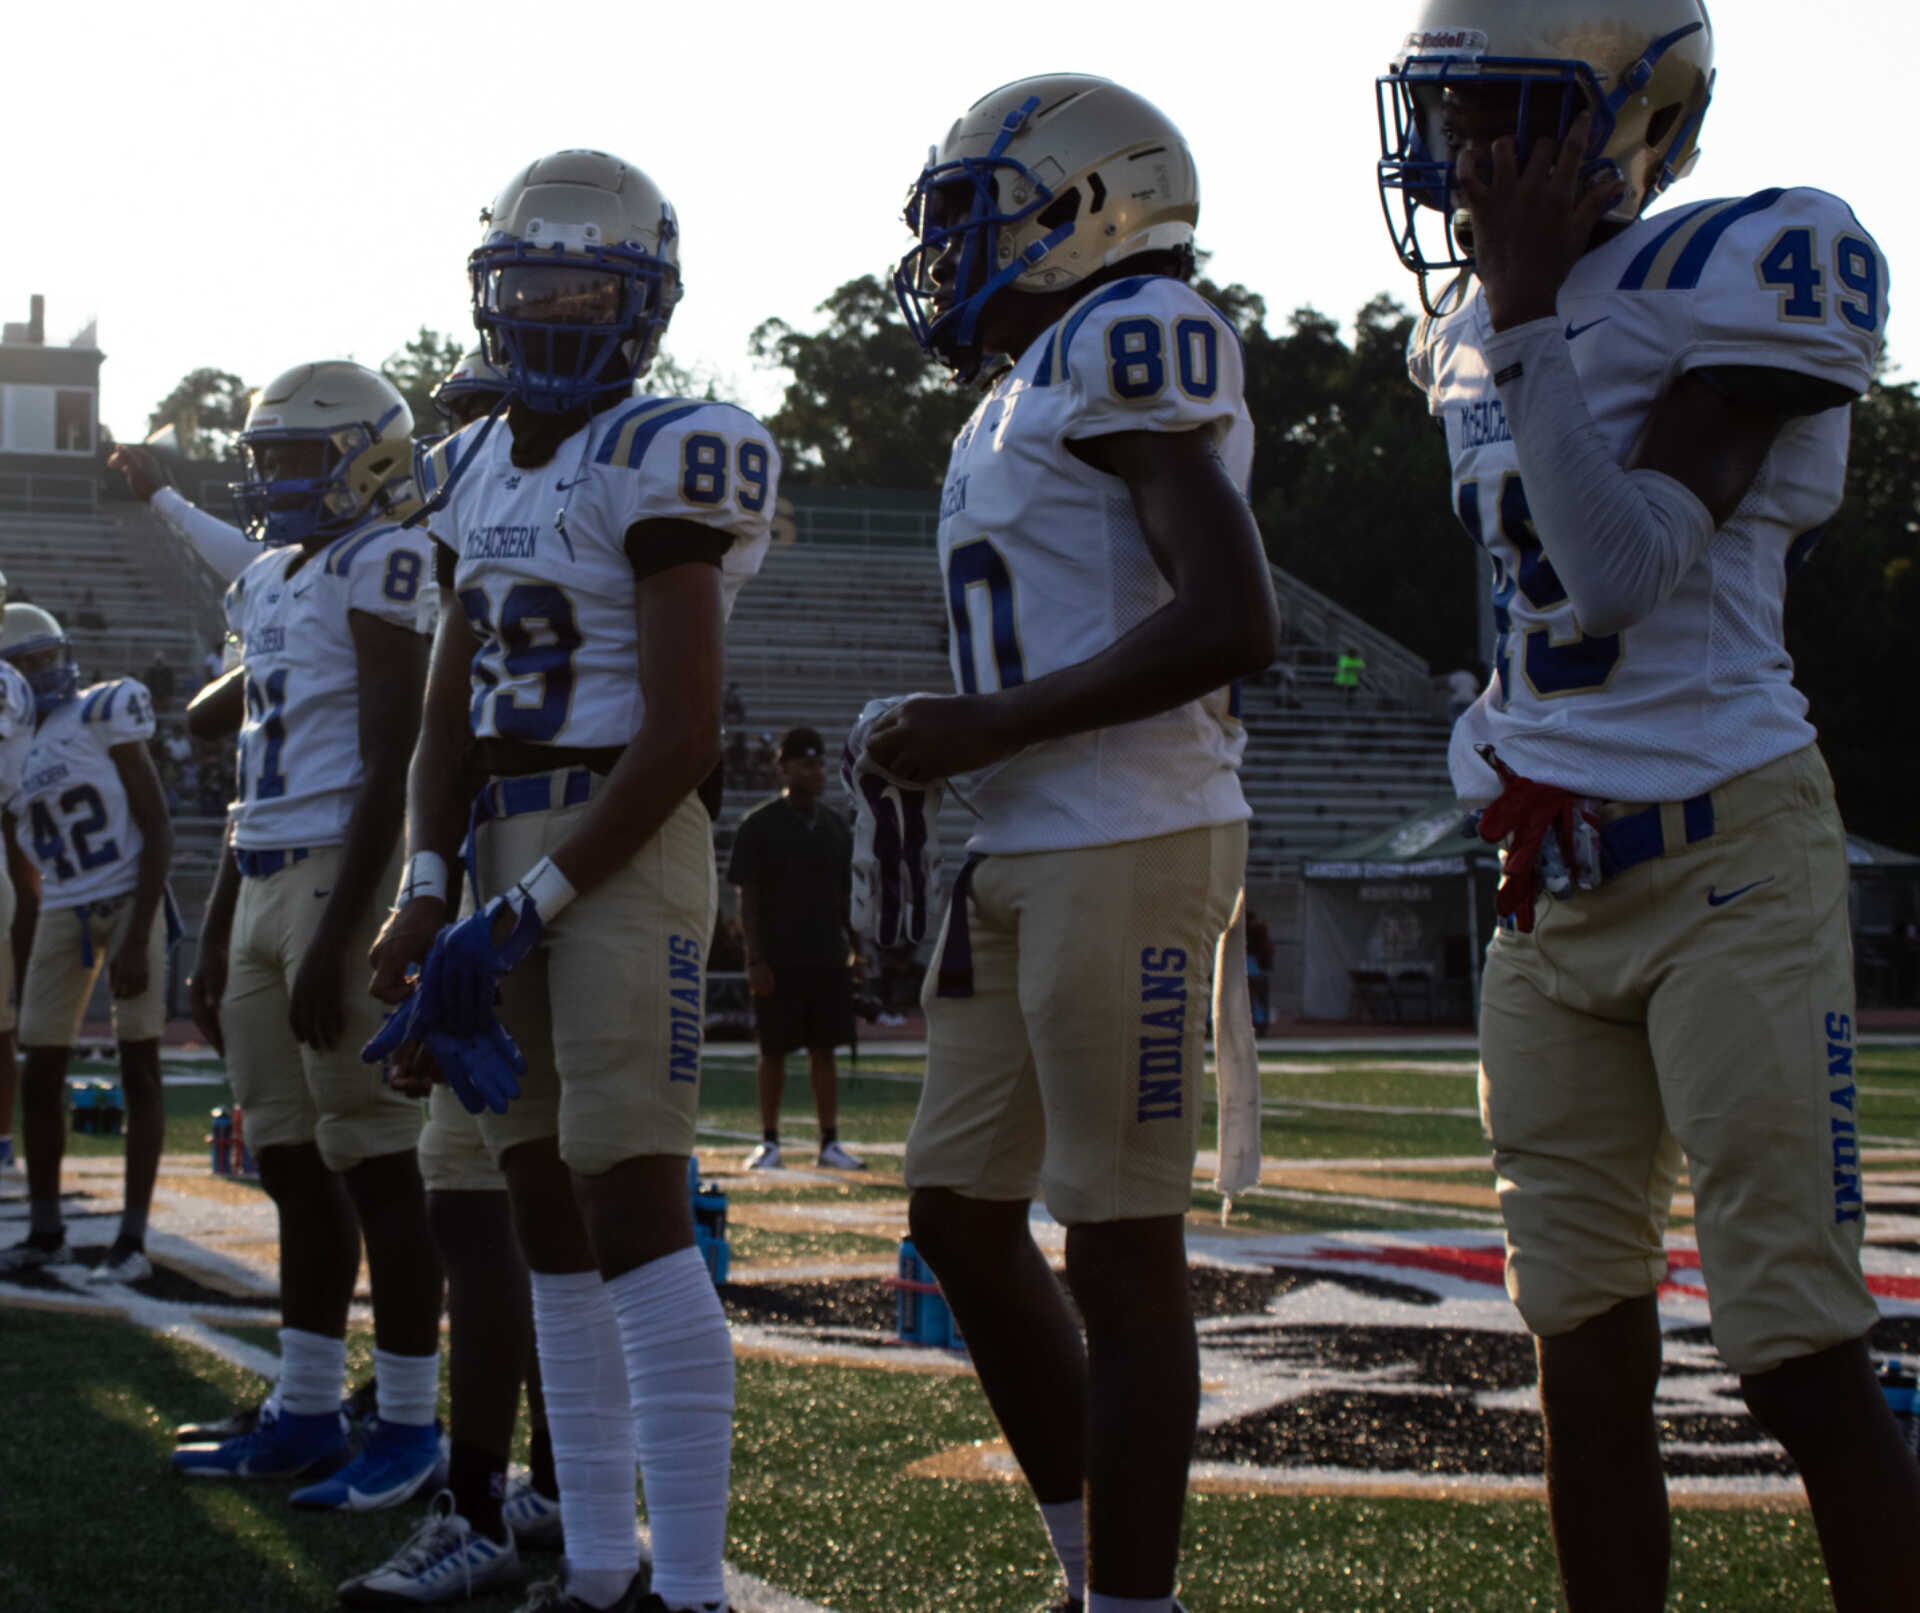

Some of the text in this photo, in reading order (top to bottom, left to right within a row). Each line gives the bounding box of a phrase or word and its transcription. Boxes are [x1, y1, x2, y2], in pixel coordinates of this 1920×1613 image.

[1754, 225, 1880, 337] 49
[1105, 314, 1217, 402] 80
[679, 430, 770, 517] 89
[384, 549, 422, 604] 8
[30, 783, 121, 883] 42
[668, 934, 701, 1084] INDIANS
[1137, 946, 1188, 1124] INDIANS
[1824, 1011, 1864, 1225] INDIANS
